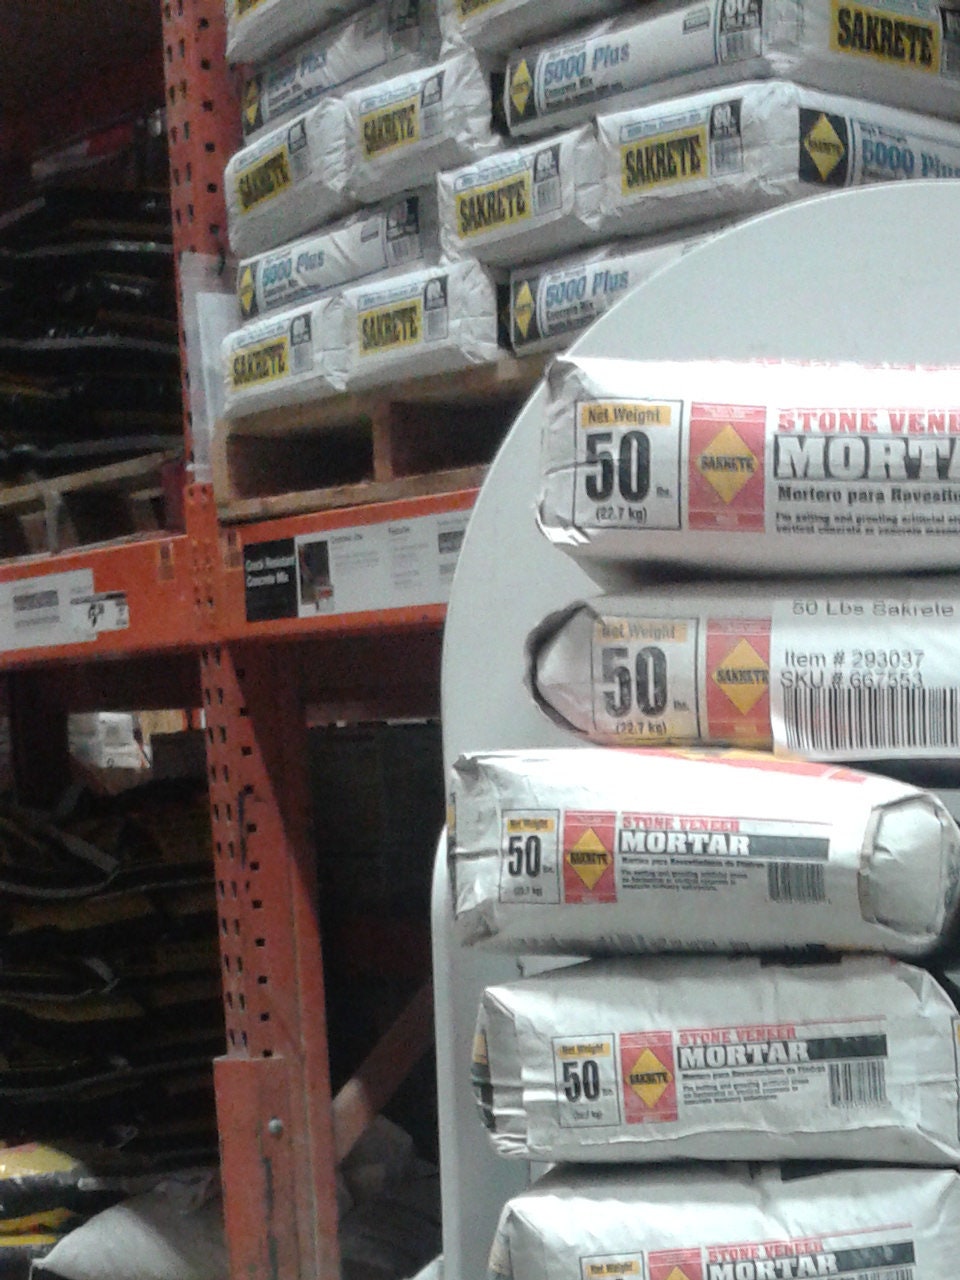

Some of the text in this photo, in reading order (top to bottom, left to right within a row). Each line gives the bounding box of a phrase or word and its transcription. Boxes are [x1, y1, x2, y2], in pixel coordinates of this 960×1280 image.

[838, 8, 932, 66] SAKRETE
[592, 42, 630, 71] Plus
[626, 135, 701, 188] SAKRETE
[460, 180, 526, 233] SAKRETE
[593, 270, 630, 296] Plus
[588, 406, 661, 425] Net Weight
[778, 411, 879, 433] STONE
[585, 429, 651, 503] 50
[701, 455, 756, 474] SAKRETE
[778, 485, 842, 502] Mortero
[848, 488, 885, 504] para
[628, 507, 648, 524] kg)
[785, 649, 926, 668] Item # 293037
[601, 645, 668, 719] 50
[780, 670, 924, 689] SKU # 667553
[622, 816, 741, 833] STONE VENEER
[508, 835, 541, 877] 50
[620, 830, 752, 857] MORTAR
[680, 1026, 797, 1045] STONE VENEER
[680, 1041, 809, 1070] MORTAR
[562, 1060, 600, 1102] 50
